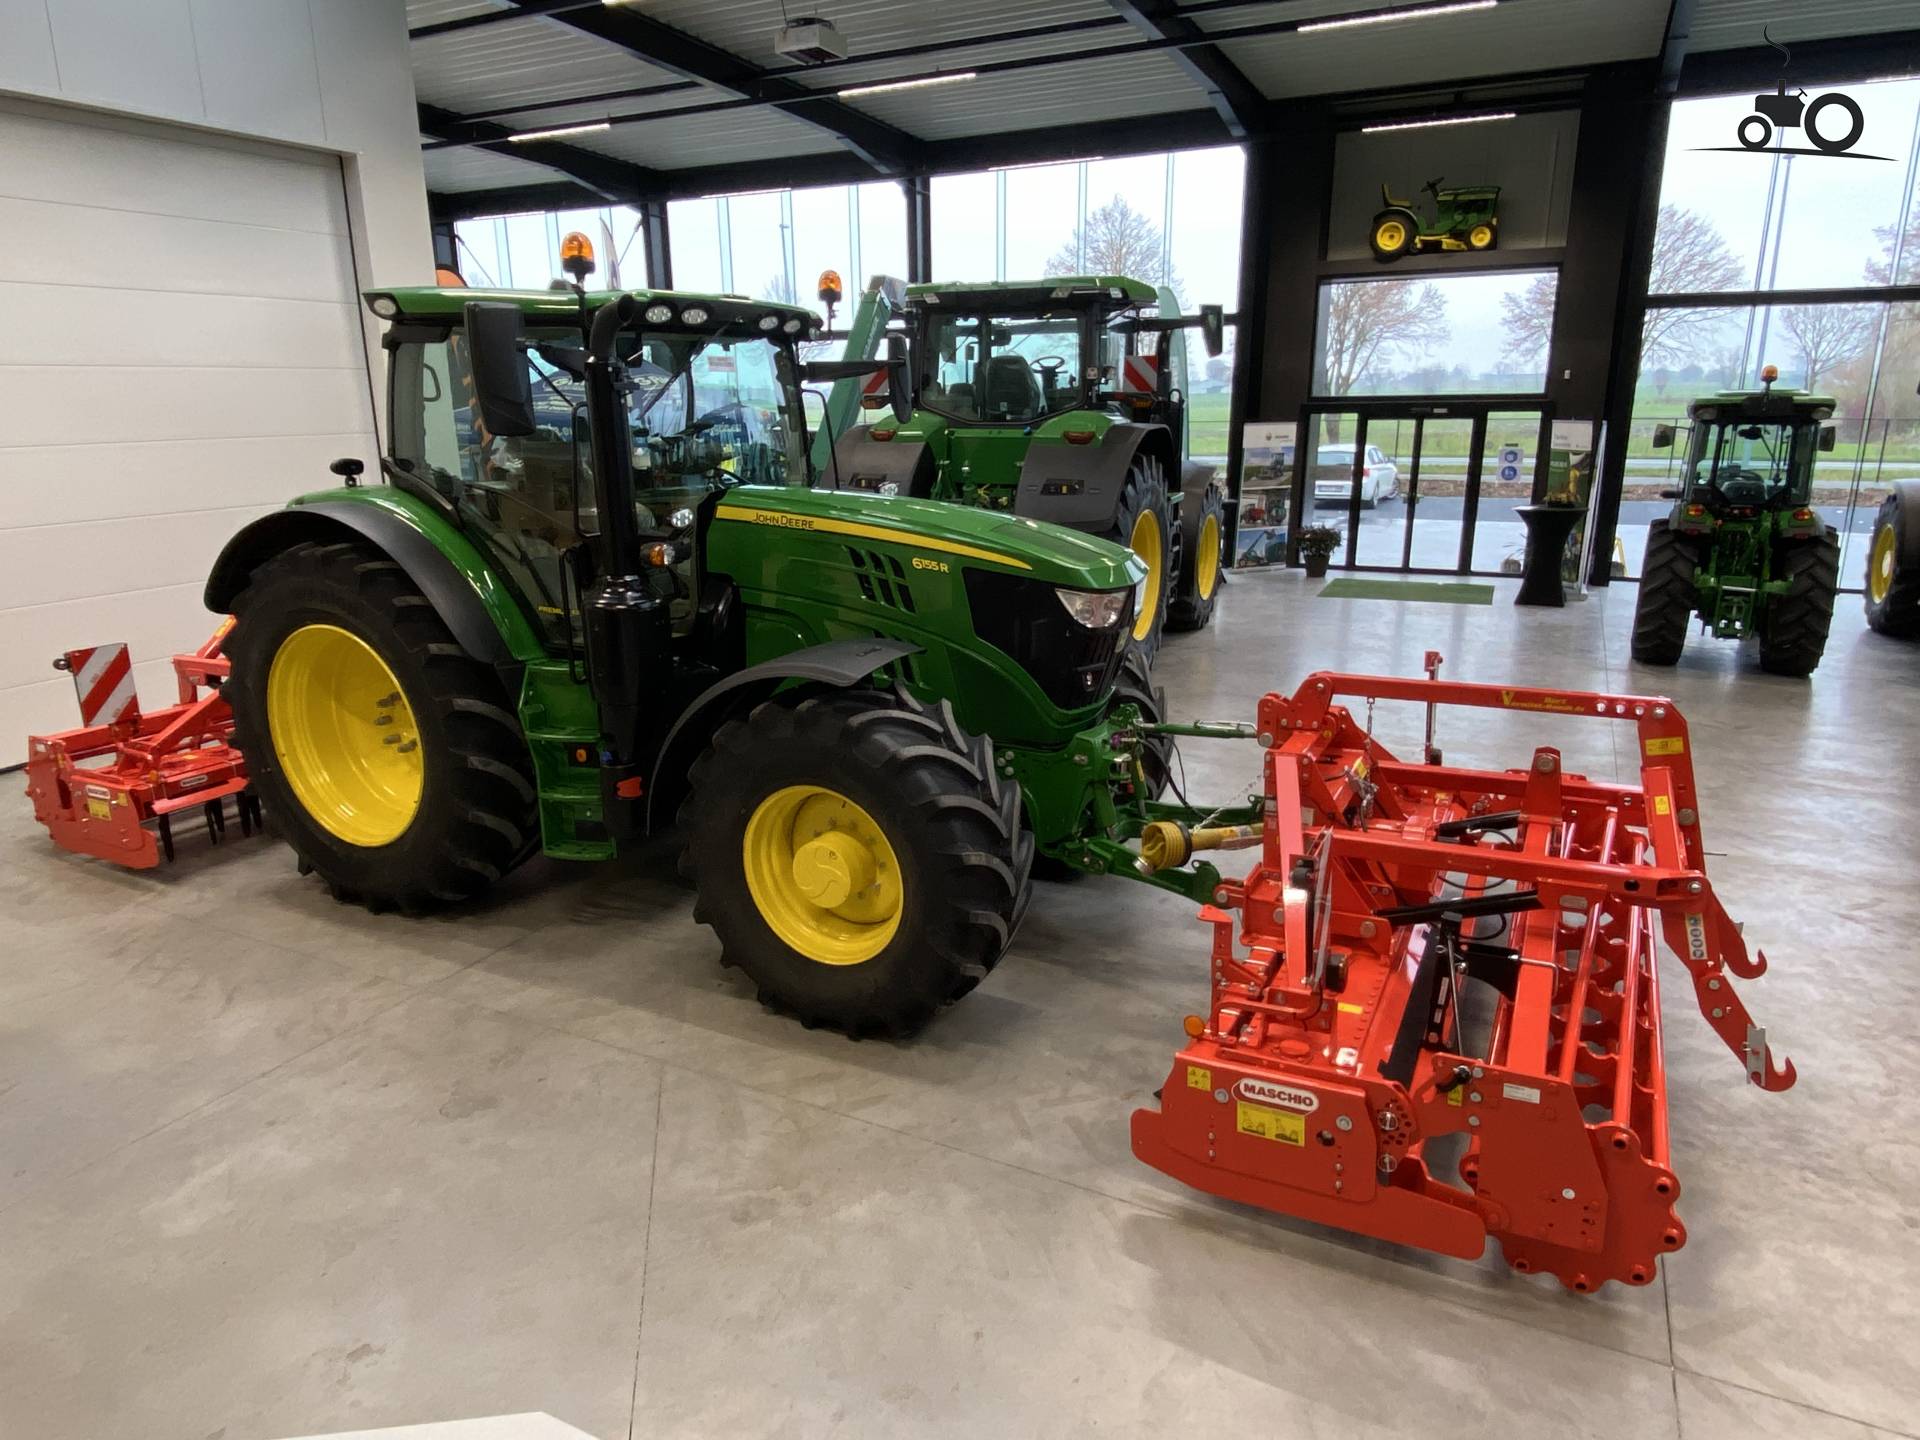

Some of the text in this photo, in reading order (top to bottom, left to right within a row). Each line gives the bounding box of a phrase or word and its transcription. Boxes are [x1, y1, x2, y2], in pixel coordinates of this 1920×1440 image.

[752, 512, 815, 529] JOHN DEERE
[1243, 1082, 1314, 1107] MASCHIO
